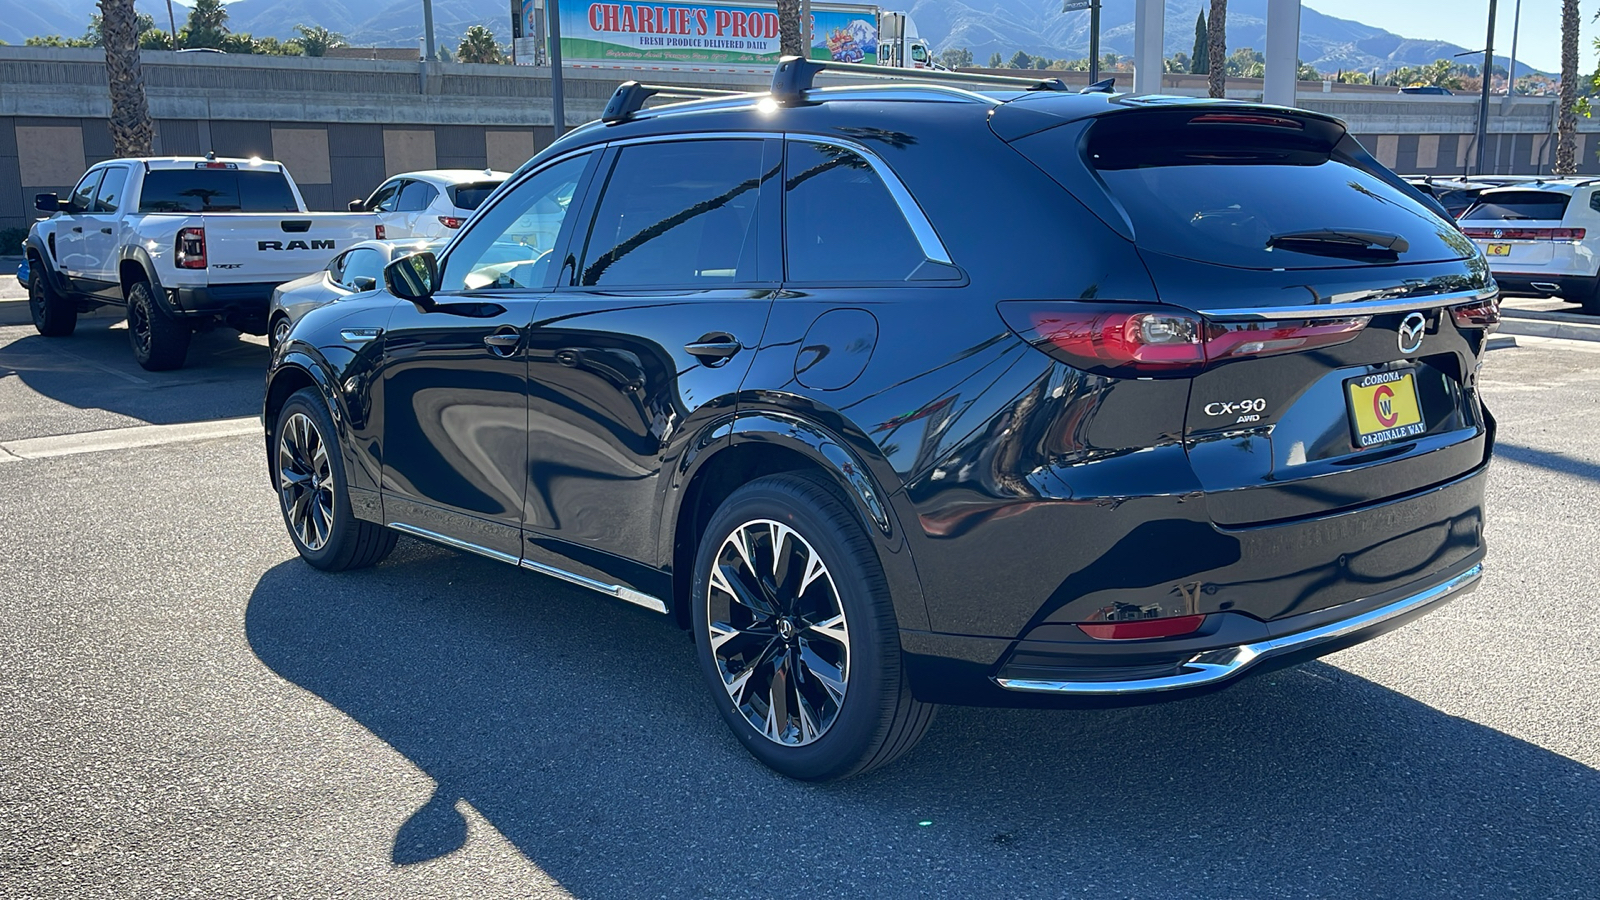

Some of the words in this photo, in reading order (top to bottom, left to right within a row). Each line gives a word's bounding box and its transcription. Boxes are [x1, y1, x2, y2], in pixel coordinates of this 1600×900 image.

[588, 3, 708, 36] CHARLIE'S
[715, 10, 815, 40] PROD
[639, 36, 664, 46] FRESH
[666, 37, 702, 47] PRODUCE
[704, 39, 745, 49] DELIVERED
[746, 40, 768, 50] DAILY
[257, 239, 336, 251] RAM
[1364, 371, 1401, 386] CORONA
[1203, 397, 1267, 416] CX-90
[1235, 414, 1261, 424] AWD
[1361, 427, 1407, 446] CARDINALE
[1407, 422, 1425, 436] WAY
